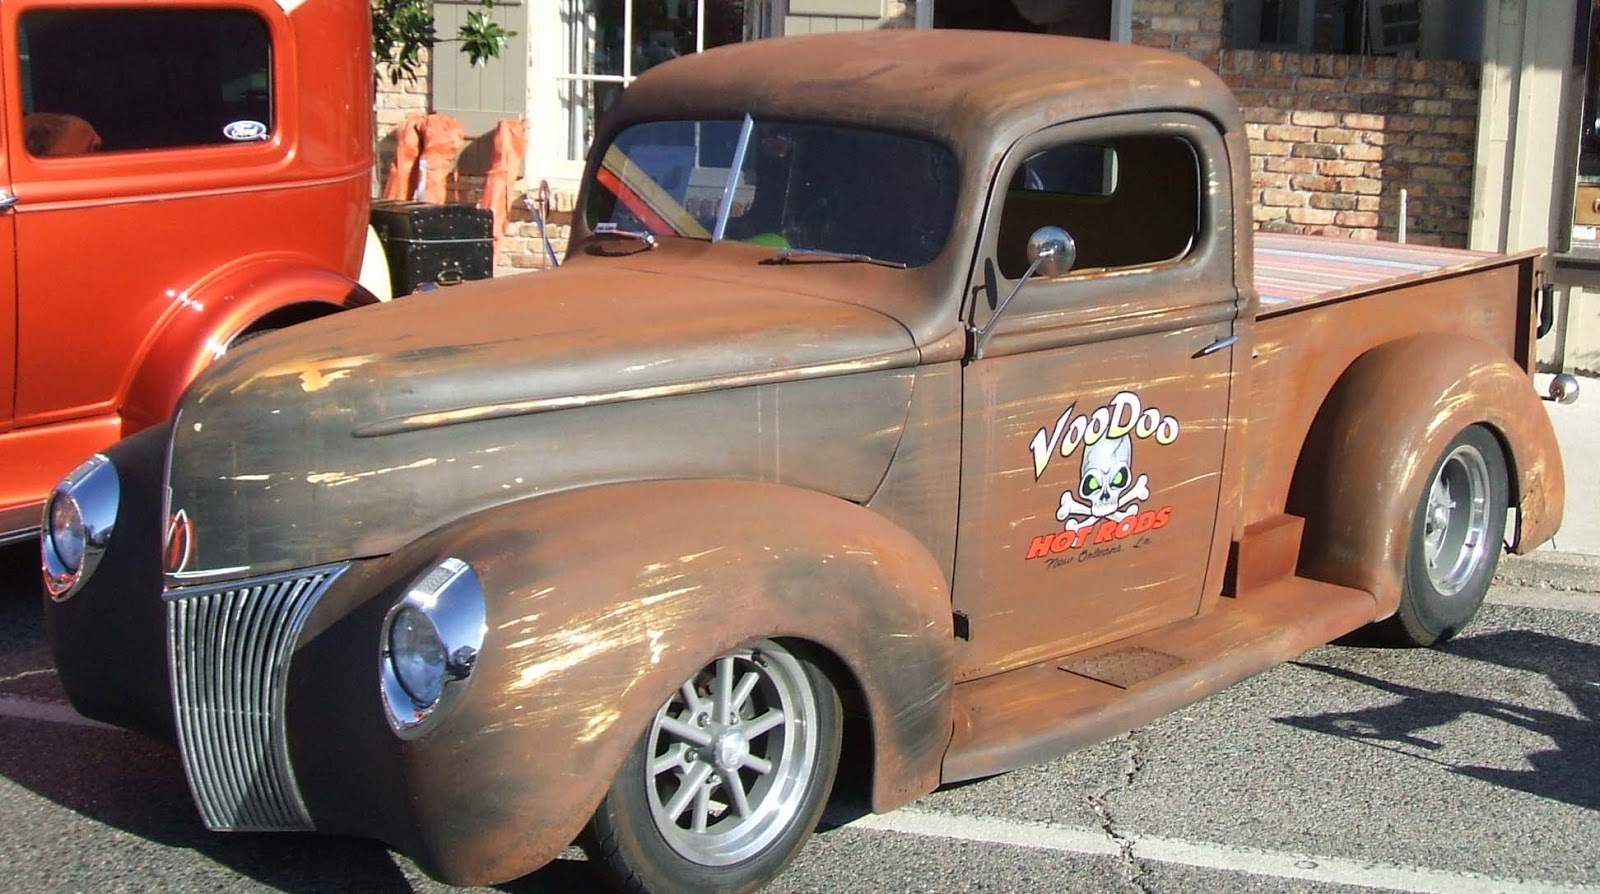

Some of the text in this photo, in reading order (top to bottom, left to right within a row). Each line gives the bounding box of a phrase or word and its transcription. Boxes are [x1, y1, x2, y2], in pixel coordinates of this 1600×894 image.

[1025, 506, 1173, 560] HOT RODS
[1045, 556, 1074, 570] New
